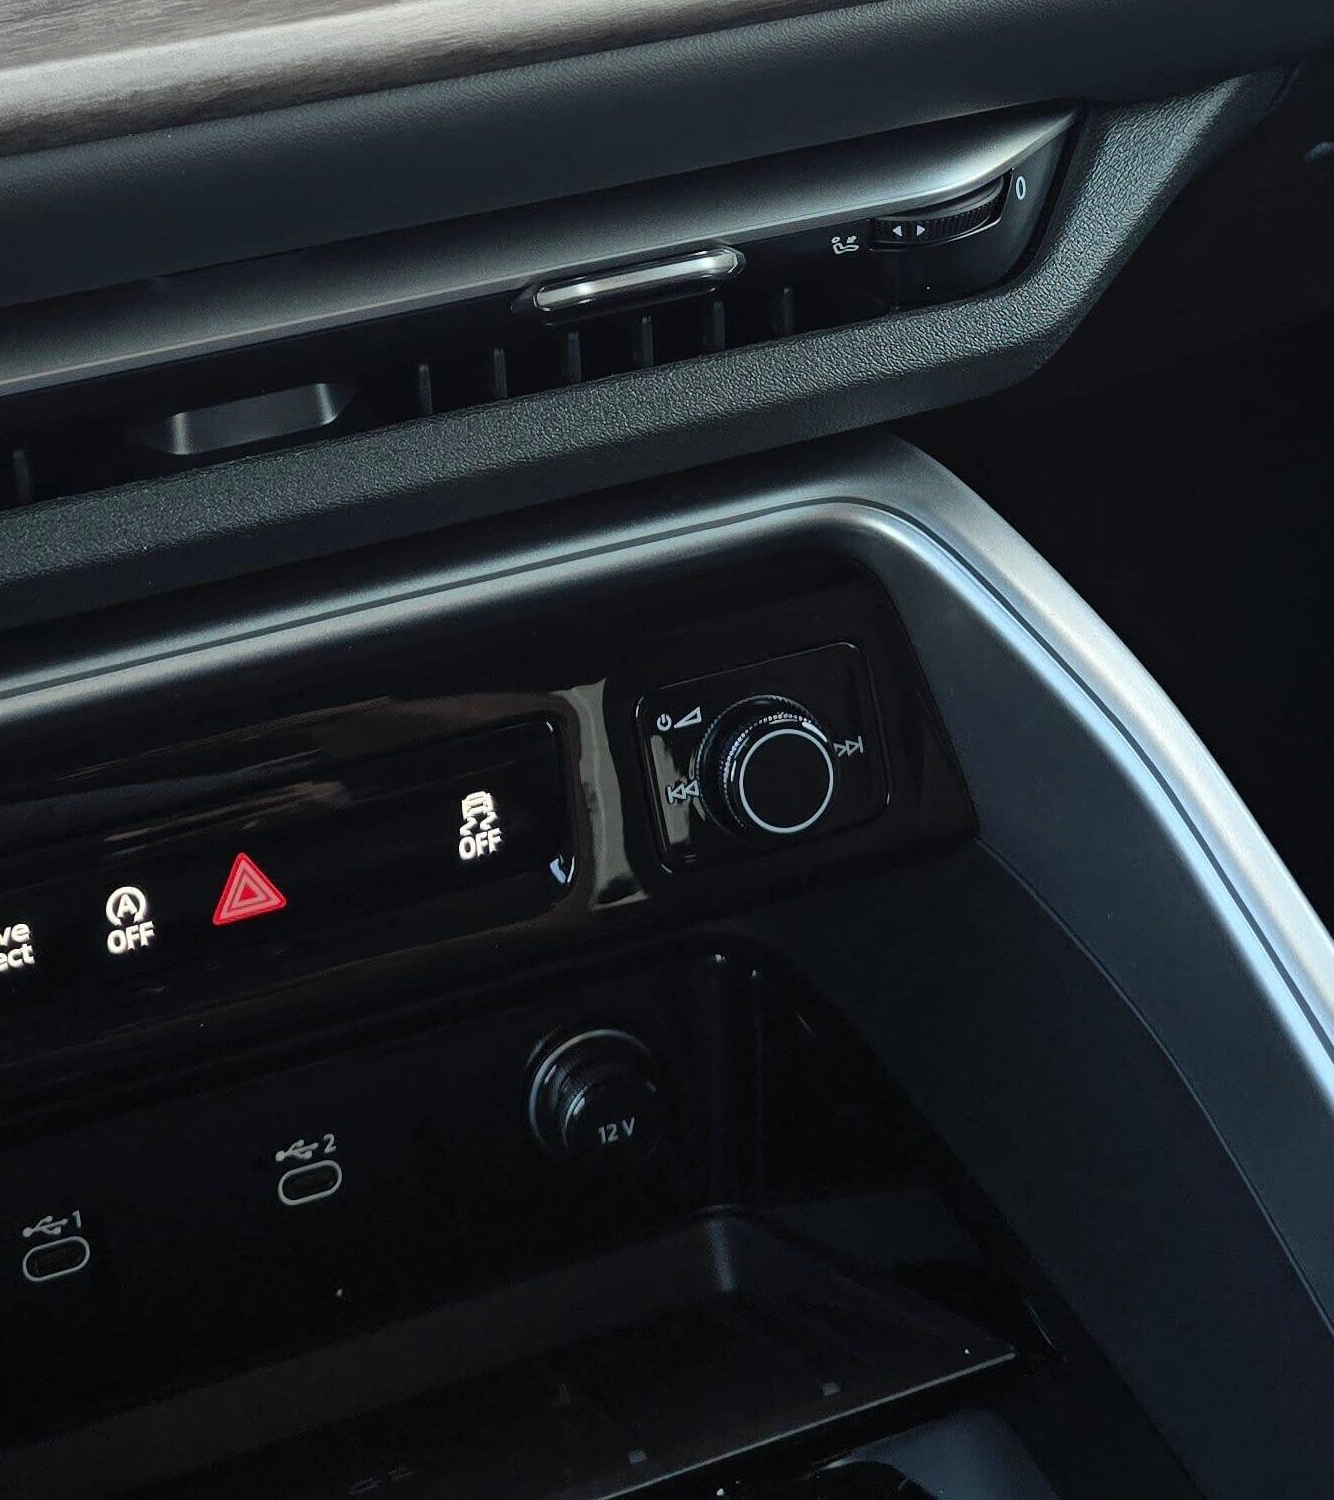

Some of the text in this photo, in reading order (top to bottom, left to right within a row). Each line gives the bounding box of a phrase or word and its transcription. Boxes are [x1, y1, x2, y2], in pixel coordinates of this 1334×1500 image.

[459, 827, 503, 861] OFF
[107, 920, 156, 955] OFF
[322, 1133, 337, 1154] 2
[598, 1115, 635, 1146] 12 V
[72, 1209, 83, 1229] 1
